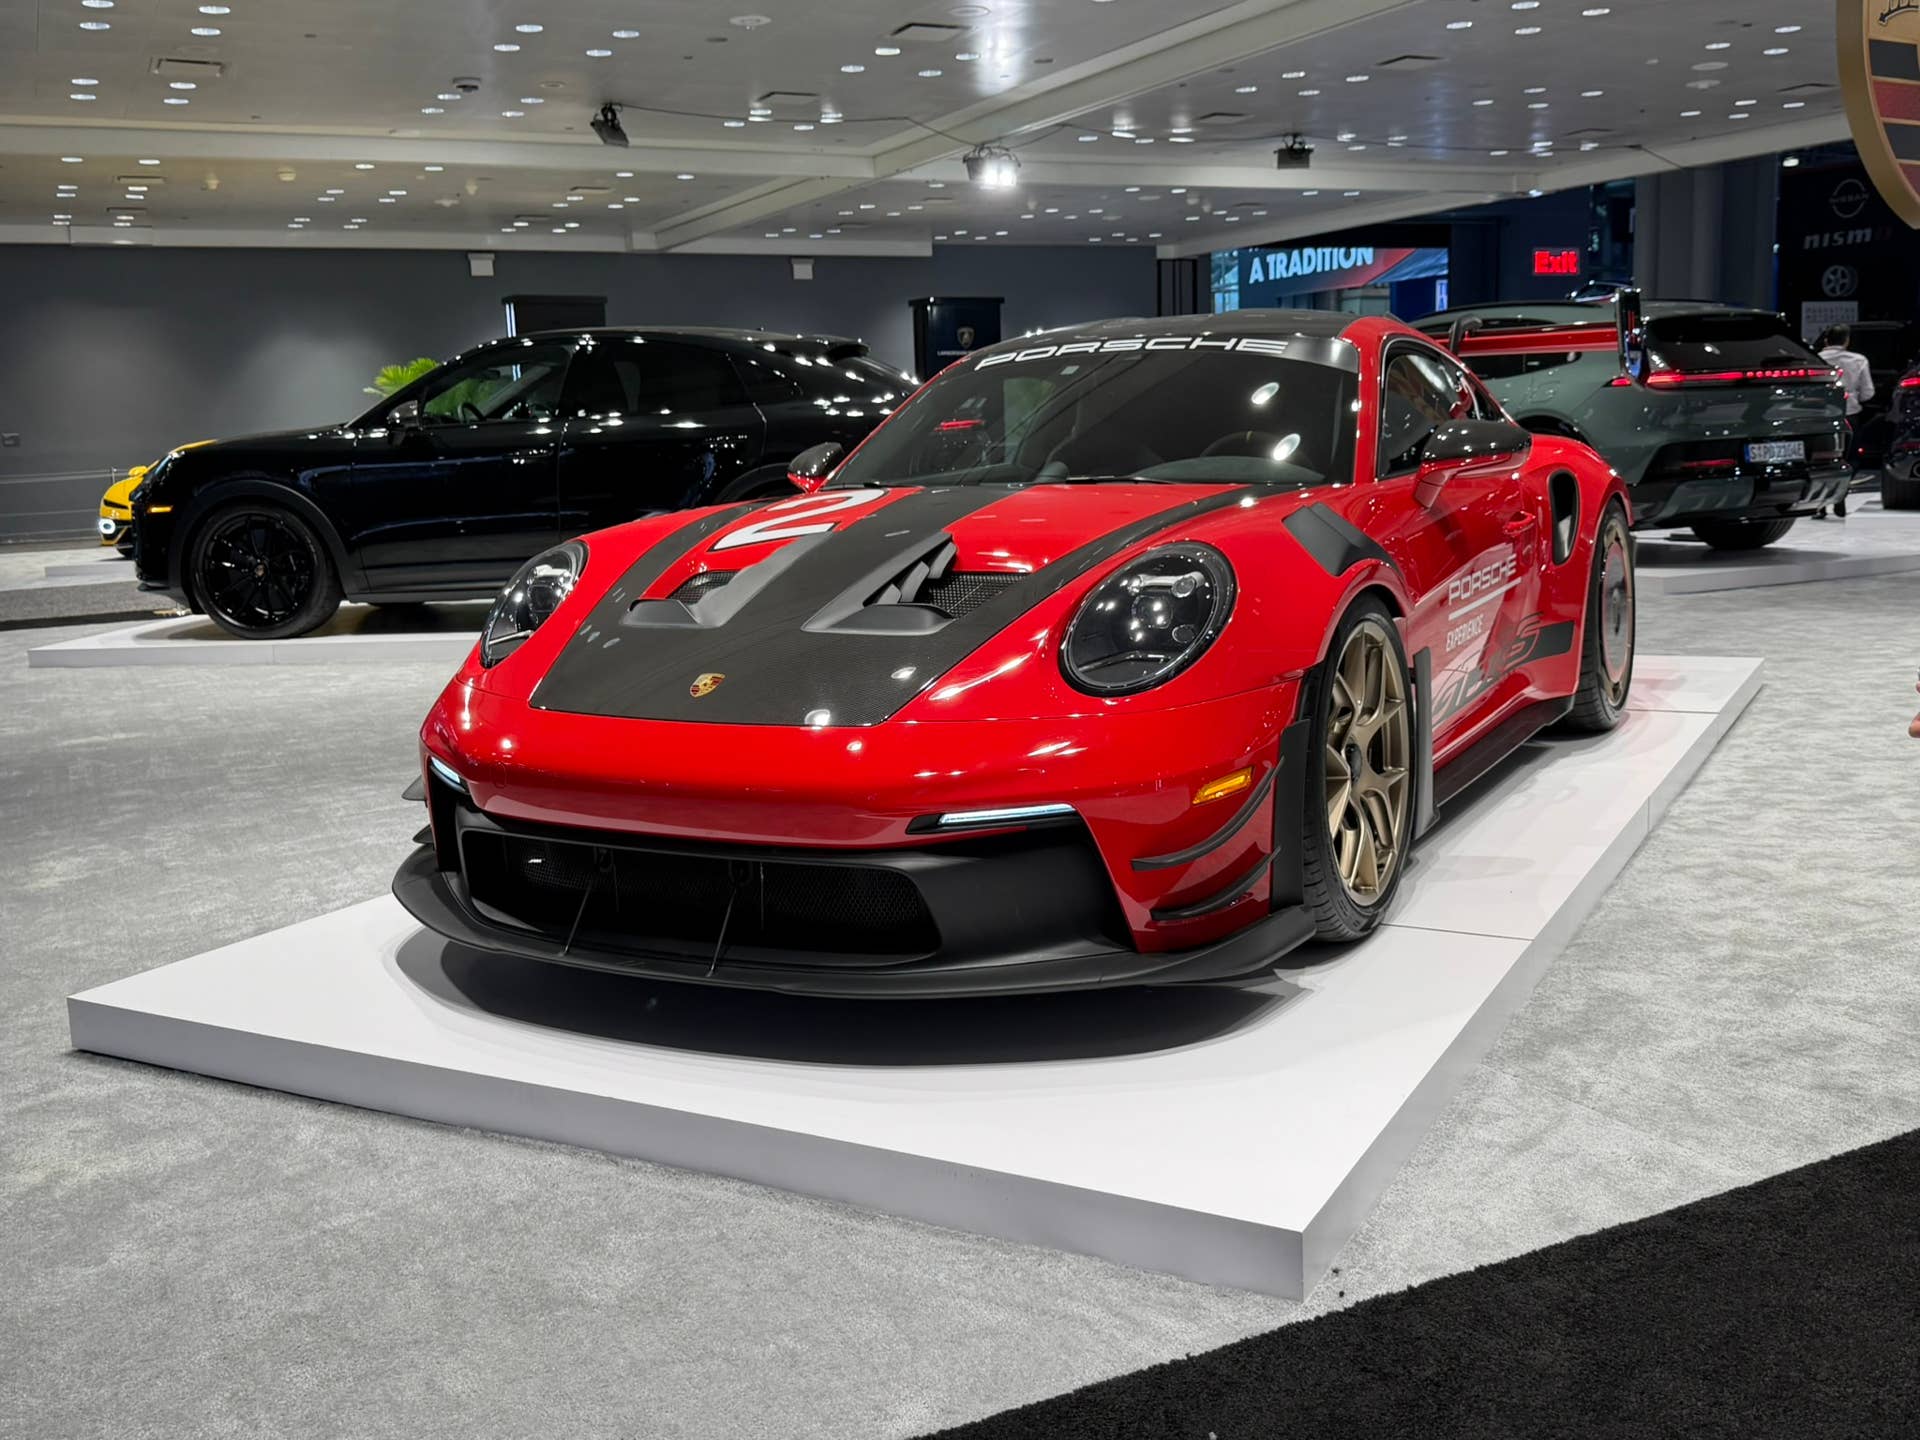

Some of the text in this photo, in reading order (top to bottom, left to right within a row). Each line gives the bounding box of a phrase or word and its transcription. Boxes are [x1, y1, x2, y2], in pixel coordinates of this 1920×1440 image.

[1249, 247, 1374, 284] A TRADITION
[1534, 250, 1578, 273] Exit
[973, 336, 1290, 371] PORSCHE
[712, 489, 889, 551] 2
[1448, 553, 1518, 606] PORSCHE
